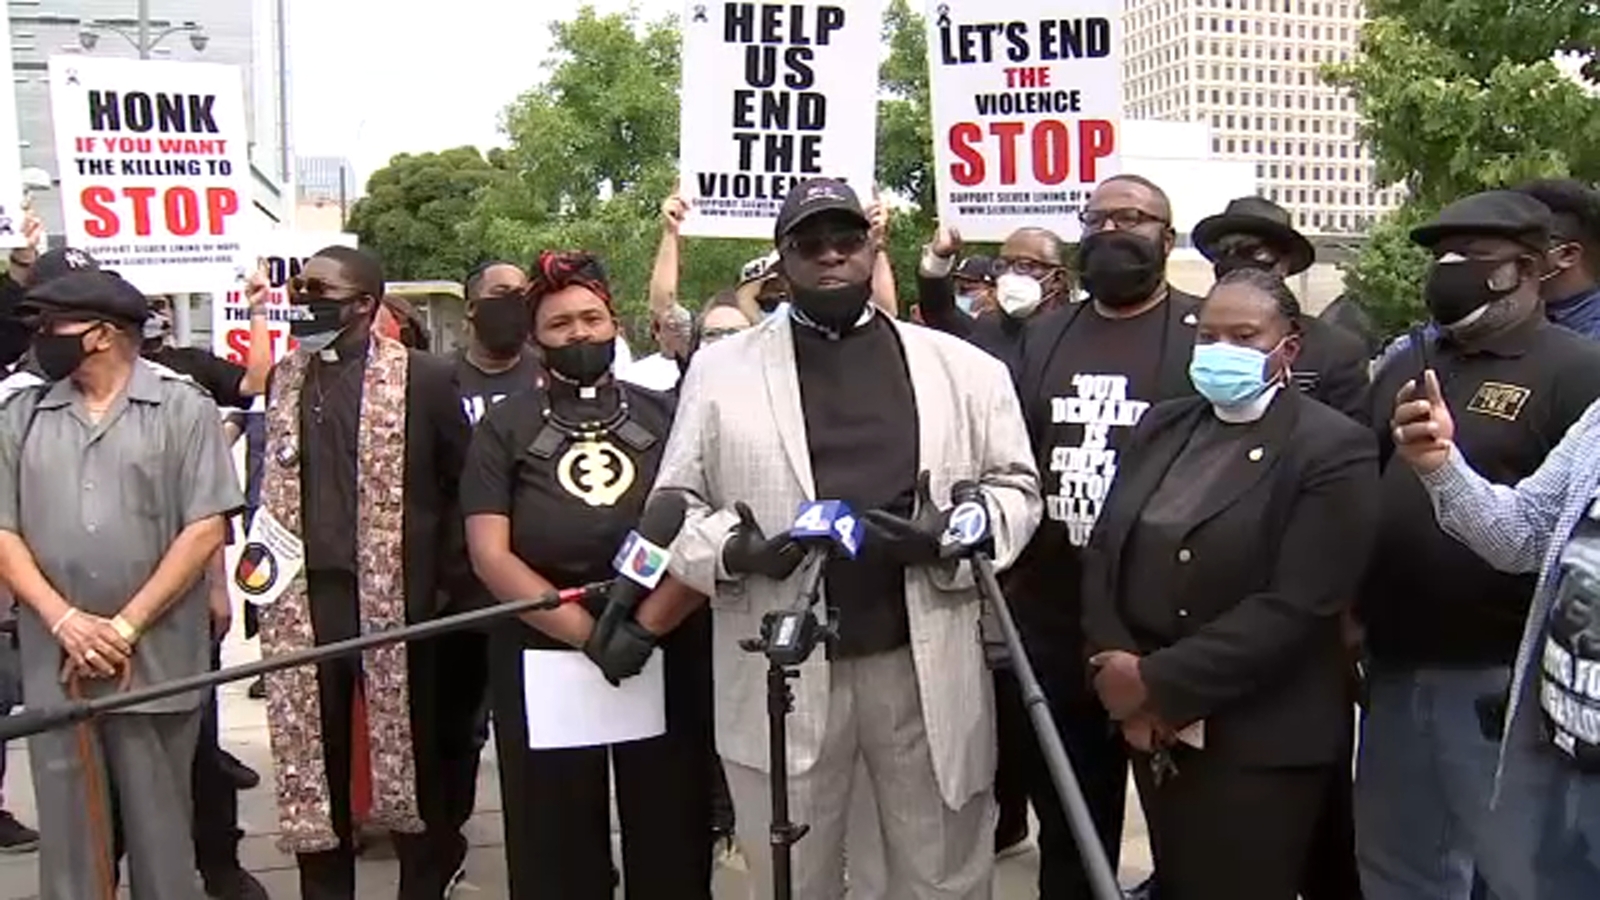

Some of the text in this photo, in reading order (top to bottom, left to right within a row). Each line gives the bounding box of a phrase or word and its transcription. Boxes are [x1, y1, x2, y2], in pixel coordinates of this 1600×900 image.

[724, 3, 845, 45] HELP
[940, 17, 1110, 65] LET'S END
[745, 45, 814, 90] US
[1003, 66, 1050, 88] THE
[88, 89, 219, 133] HONK
[732, 89, 826, 131] END
[974, 90, 1081, 115] VIOLENCE
[75, 136, 227, 155] IF YOU WANT
[732, 132, 822, 173] THE
[948, 119, 1114, 187] STOP
[75, 158, 232, 176] THE KILLING TO
[80, 185, 239, 238] STOP
[224, 307, 252, 320] TH
[795, 504, 830, 531] 4
